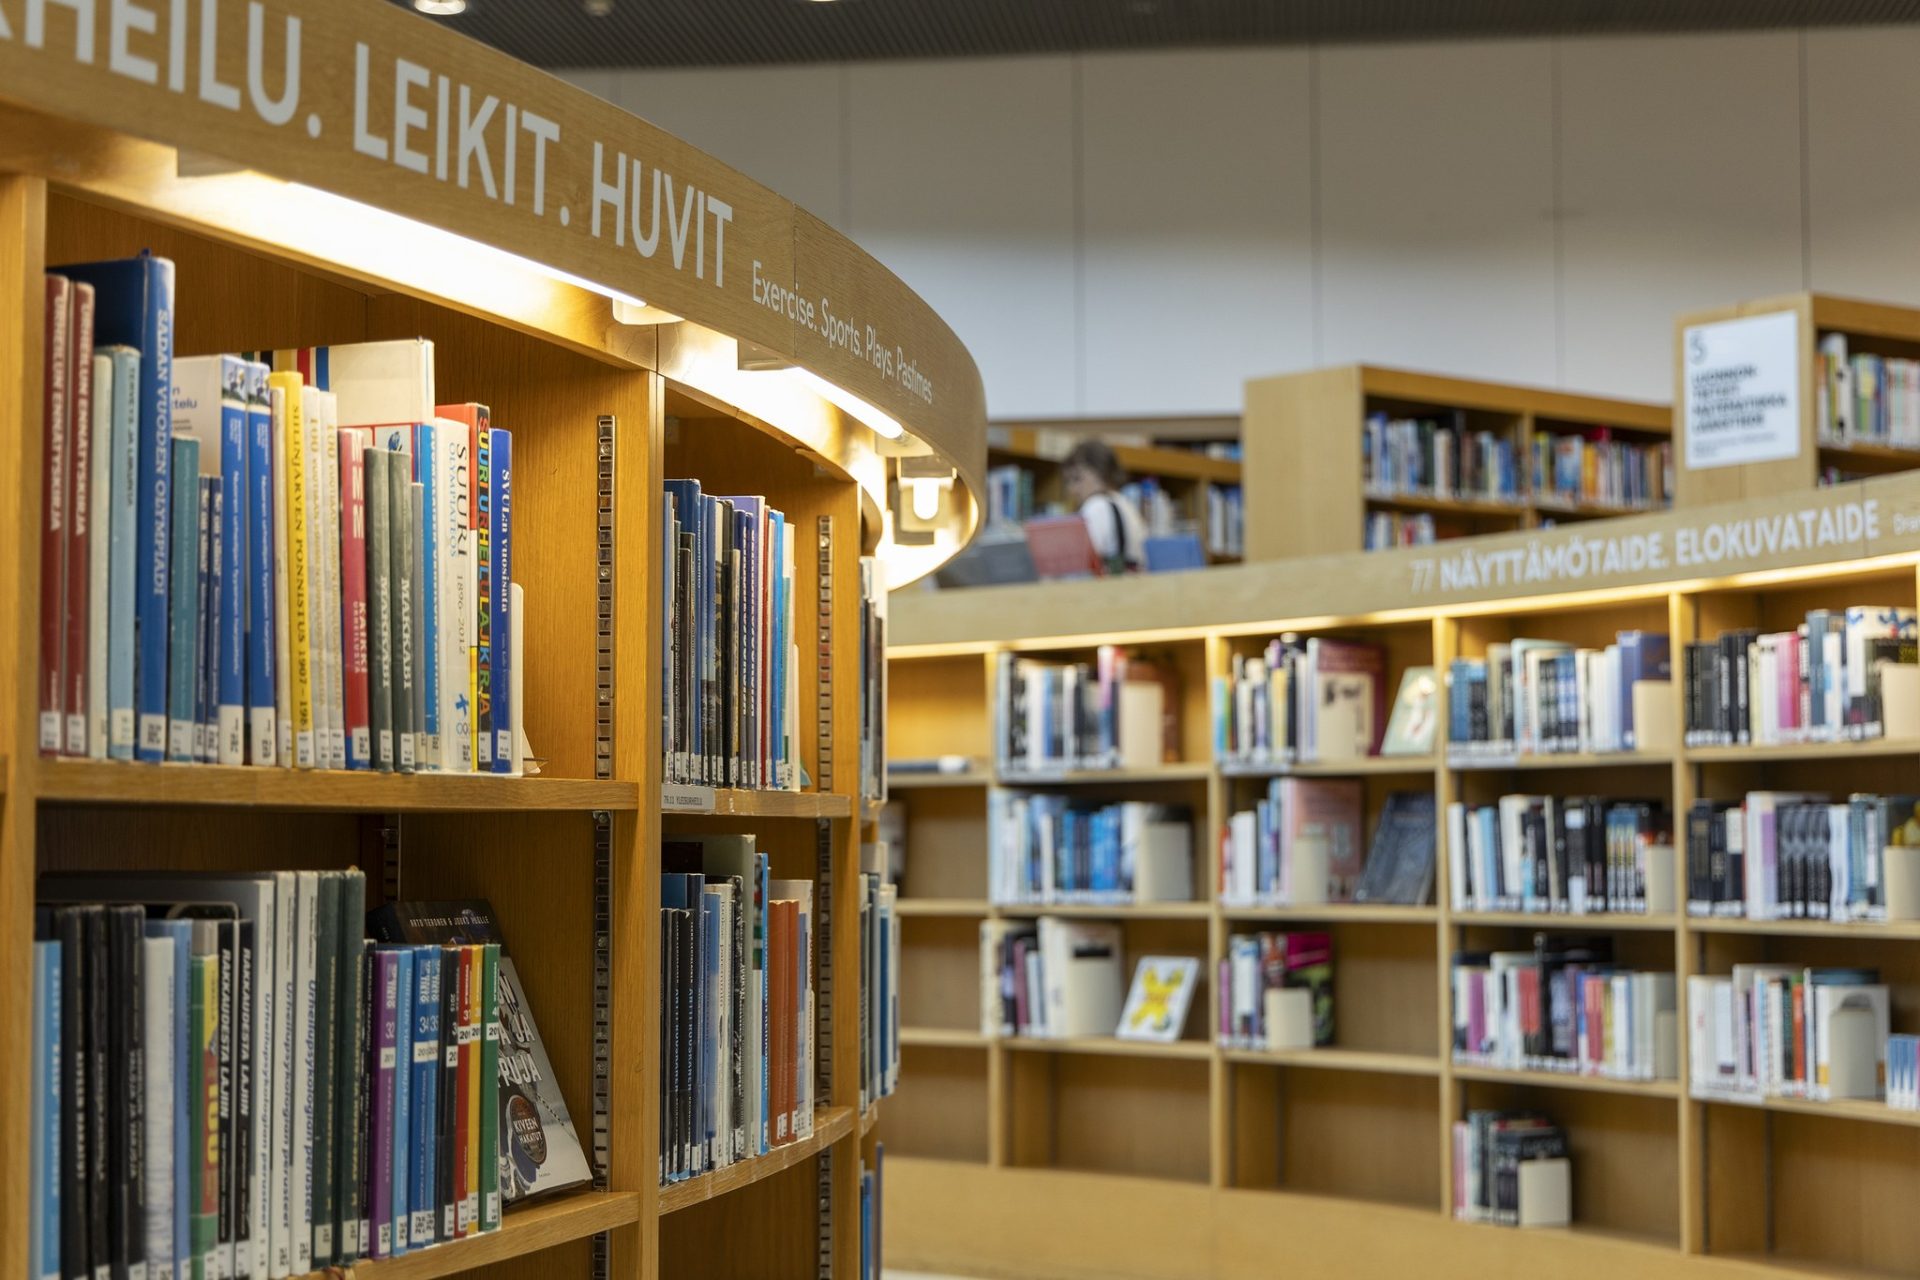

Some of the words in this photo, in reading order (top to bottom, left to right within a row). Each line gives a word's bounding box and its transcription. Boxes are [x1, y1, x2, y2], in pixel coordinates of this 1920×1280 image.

[354, 42, 569, 227] LEIKIT.
[592, 141, 732, 288] HUVIT
[157, 310, 169, 380] SADAN
[753, 260, 817, 331] Exercise.
[821, 298, 862, 357] Sports.
[866, 325, 894, 379] Plays.
[897, 346, 932, 403] Pastimes
[155, 386, 168, 474] VUODEN
[292, 404, 304, 531] SIILINJÄRVEN
[479, 417, 489, 488] SUURI
[153, 480, 167, 595] OLYMPIADI
[449, 442, 457, 558] OLYMPIATEOS
[457, 443, 468, 557] SUURI
[1409, 558, 1436, 594] 77
[1439, 532, 1669, 591] NÄYTTÄMÖTAIDE.
[1676, 498, 1880, 565] ELOKUVATAIDE
[296, 538, 306, 643] PONNISTUS
[479, 494, 490, 716] URHEILULAJIKIRJA
[501, 538, 510, 613] vuosisata
[352, 601, 360, 674] URHEILUSTA
[359, 601, 368, 673] KAIKKI
[380, 575, 389, 689] MAKKABI
[401, 577, 411, 690] MAKKABI
[300, 700, 309, 732] 198
[221, 949, 231, 1063] RAKKAUDESTA
[241, 947, 251, 1060] RAKKAUDESTA
[220, 1066, 230, 1119] LAJIIN
[240, 1064, 250, 1116] LAJIIN
[304, 980, 316, 1142] Urheilupsykologian
[499, 1052, 542, 1088] PUJA
[512, 1116, 539, 1134] KIVEEN
